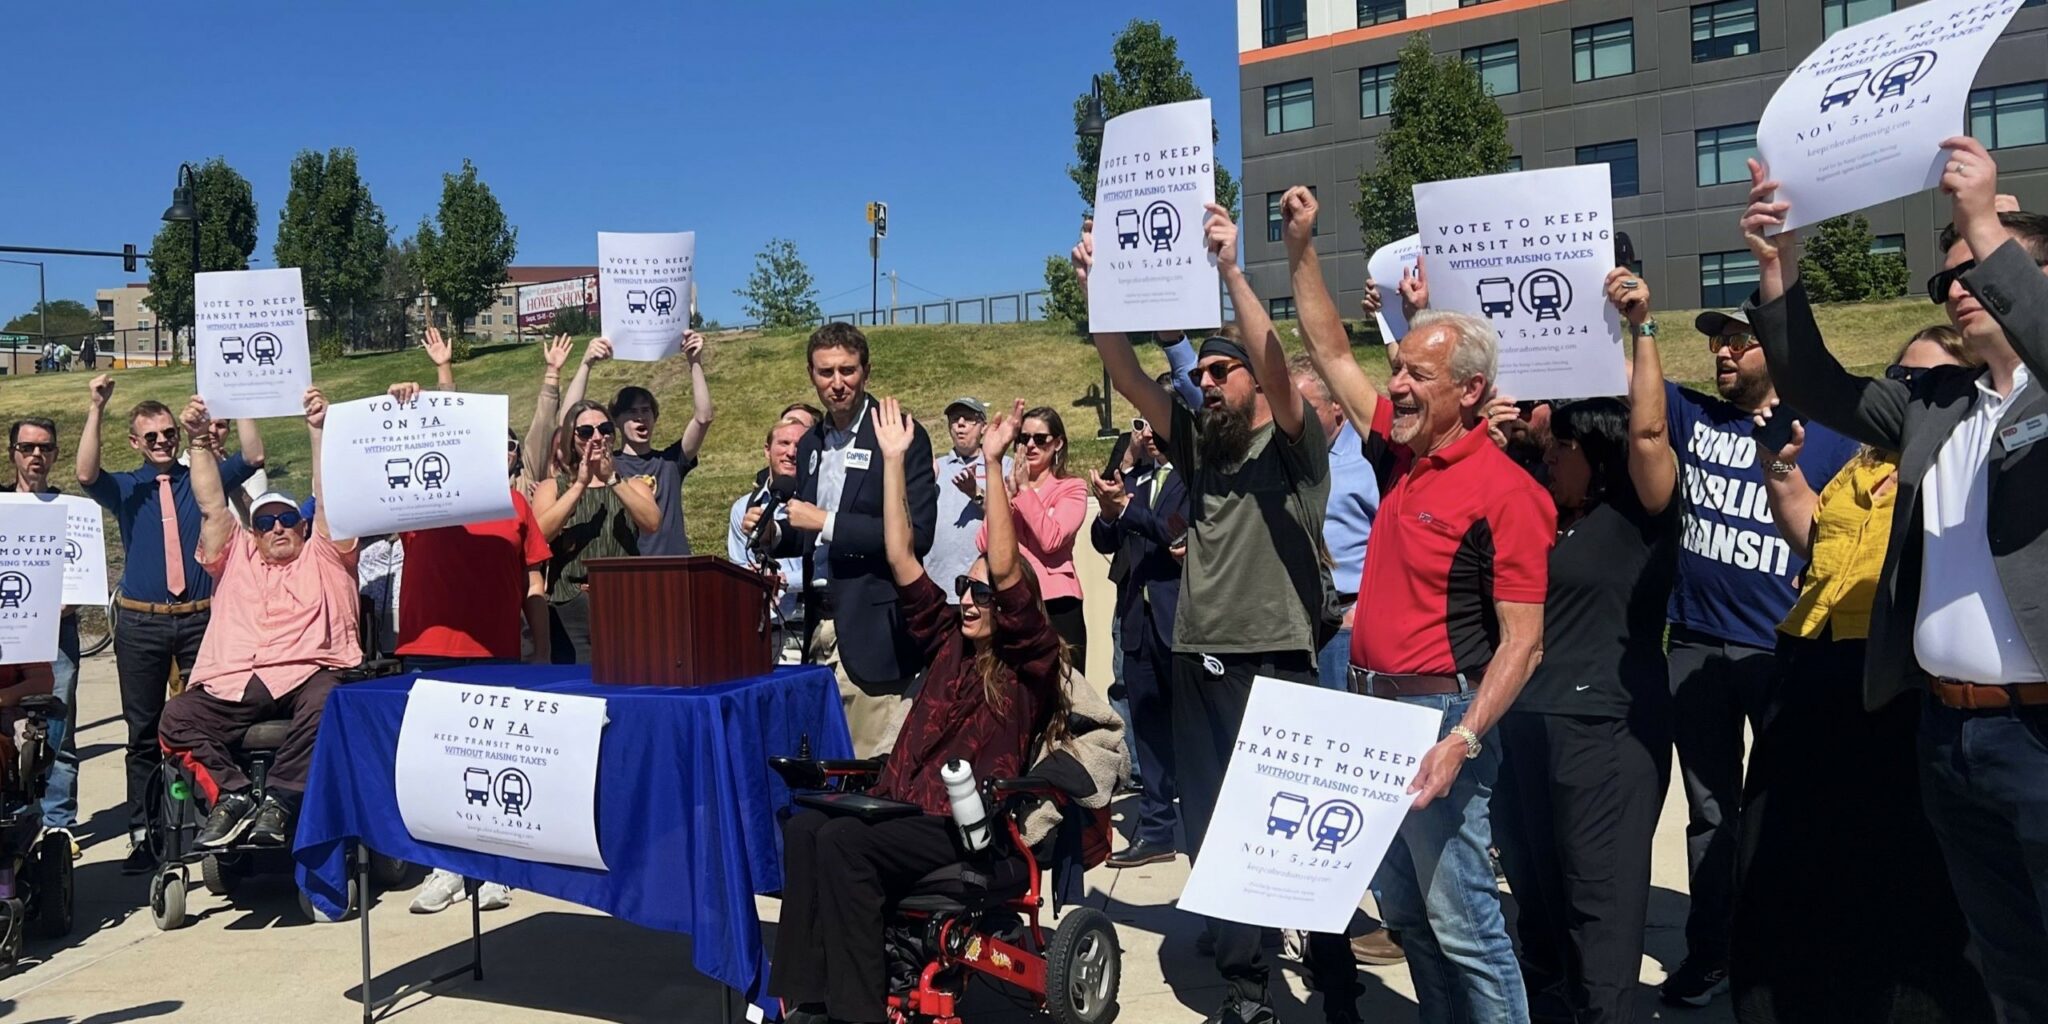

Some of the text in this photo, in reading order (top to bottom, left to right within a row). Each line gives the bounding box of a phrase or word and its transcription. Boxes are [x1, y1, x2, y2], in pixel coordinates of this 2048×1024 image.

[1796, 6, 2014, 74] TRANSIT MOVING
[1830, 33, 1889, 54] VOTE
[1905, 20, 1932, 32] TO
[1815, 24, 1986, 76] WITHOUT RAISING TAXES
[1796, 94, 1930, 144] NOV 5,2024
[1104, 146, 1201, 169] VOTE TO KEEP
[1145, 163, 1210, 180] MOVING
[1103, 182, 1198, 202] WITHOUT RAISING TAXES
[1439, 211, 1598, 236] VOTE TO KEEP
[1422, 230, 1610, 255] TRANSIT MOVING
[654, 265, 693, 274] MOVING
[666, 256, 690, 264] KEEP
[1110, 256, 1192, 270] NOV 5,2024
[1450, 249, 1594, 270] WITHOUT RAISING TAXES
[264, 297, 296, 306] KEEP
[527, 296, 555, 311] HOME
[196, 308, 304, 320] TRANSIT MOVING
[206, 323, 237, 331] WITHOUT
[1519, 325, 1588, 339] 5,2024
[370, 398, 464, 412] VOTE YES
[383, 416, 441, 430] ON 7A
[352, 429, 472, 444] KEEP TRANSIT MOVING
[364, 438, 461, 454] WITHOUT RAISING TAXES
[1688, 420, 1757, 469] FUND
[380, 496, 404, 504] NOV
[1682, 464, 1774, 524] PUBLIC
[66, 524, 102, 532] OVING
[461, 692, 560, 714] VOTE YES
[469, 716, 531, 736] ON 7A
[434, 732, 560, 756] KEEP TRANSIT MOVING
[1262, 726, 1416, 768] VOTE TO KEEP
[444, 746, 548, 766] WITHOUT RAISING TAXES
[1238, 741, 1406, 787] TRANSIT MOVIN
[1255, 763, 1400, 804] WITHOUT RAISING TAXES
[456, 811, 484, 822] NOV
[1242, 843, 1352, 870] NOV 5,2024
